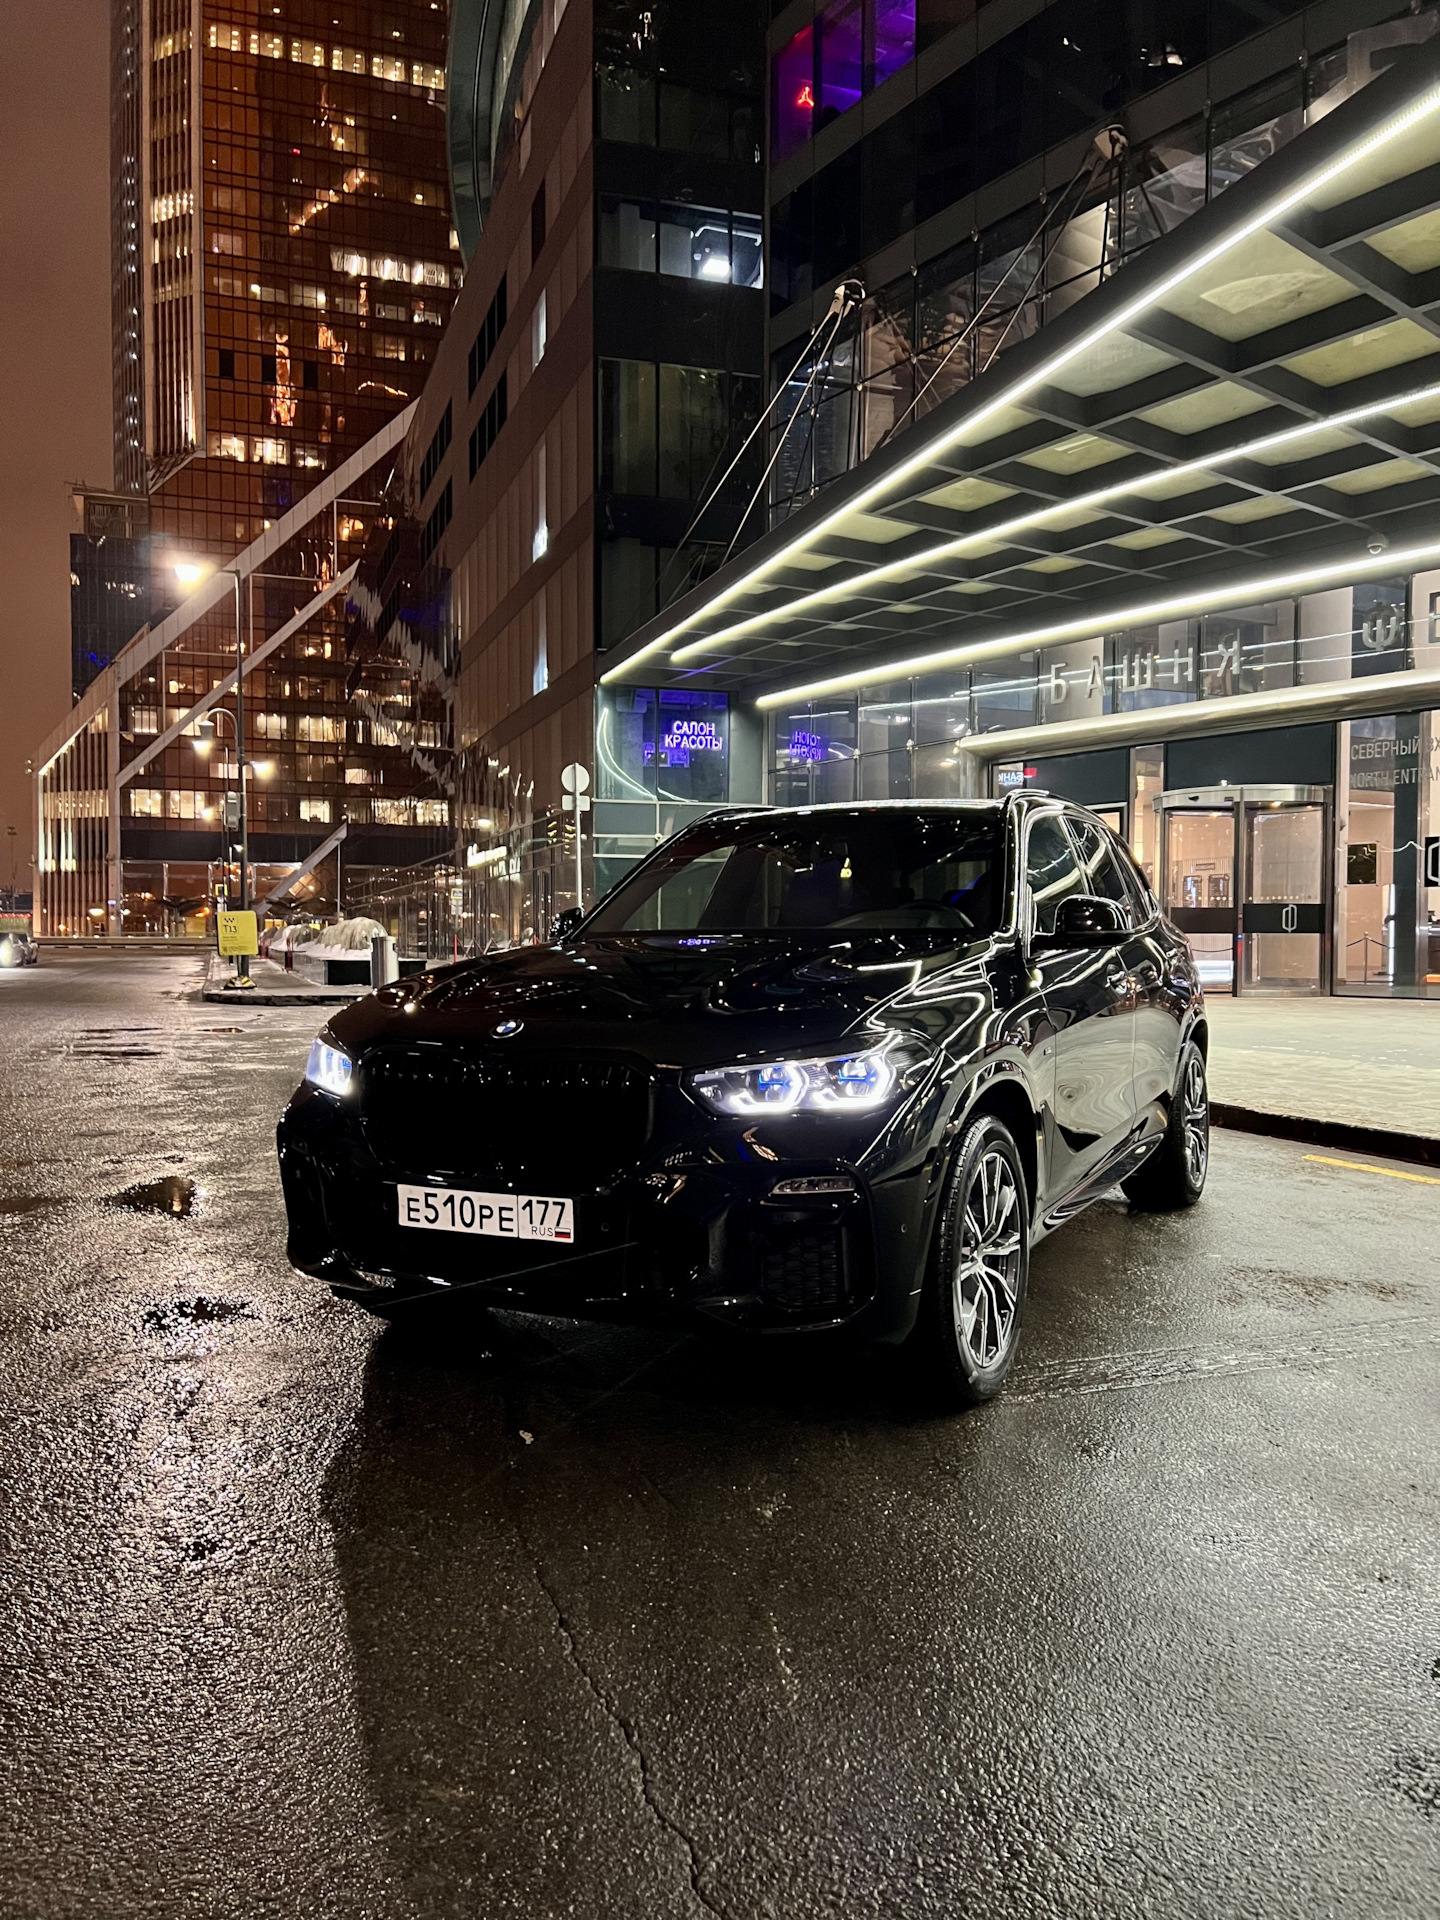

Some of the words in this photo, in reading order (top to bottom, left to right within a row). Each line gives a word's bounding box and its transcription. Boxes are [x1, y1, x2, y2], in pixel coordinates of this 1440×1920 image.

[1050, 634, 1241, 705] БАШНЯ
[673, 720, 716, 736] САЛОН
[664, 734, 723, 751] КРАСОТЫ
[1351, 735, 1420, 760] СЕВЕРНЫЙ
[406, 1192, 514, 1233] Е510РЕ
[521, 1199, 566, 1228] 177
[531, 1226, 554, 1237] RUS
